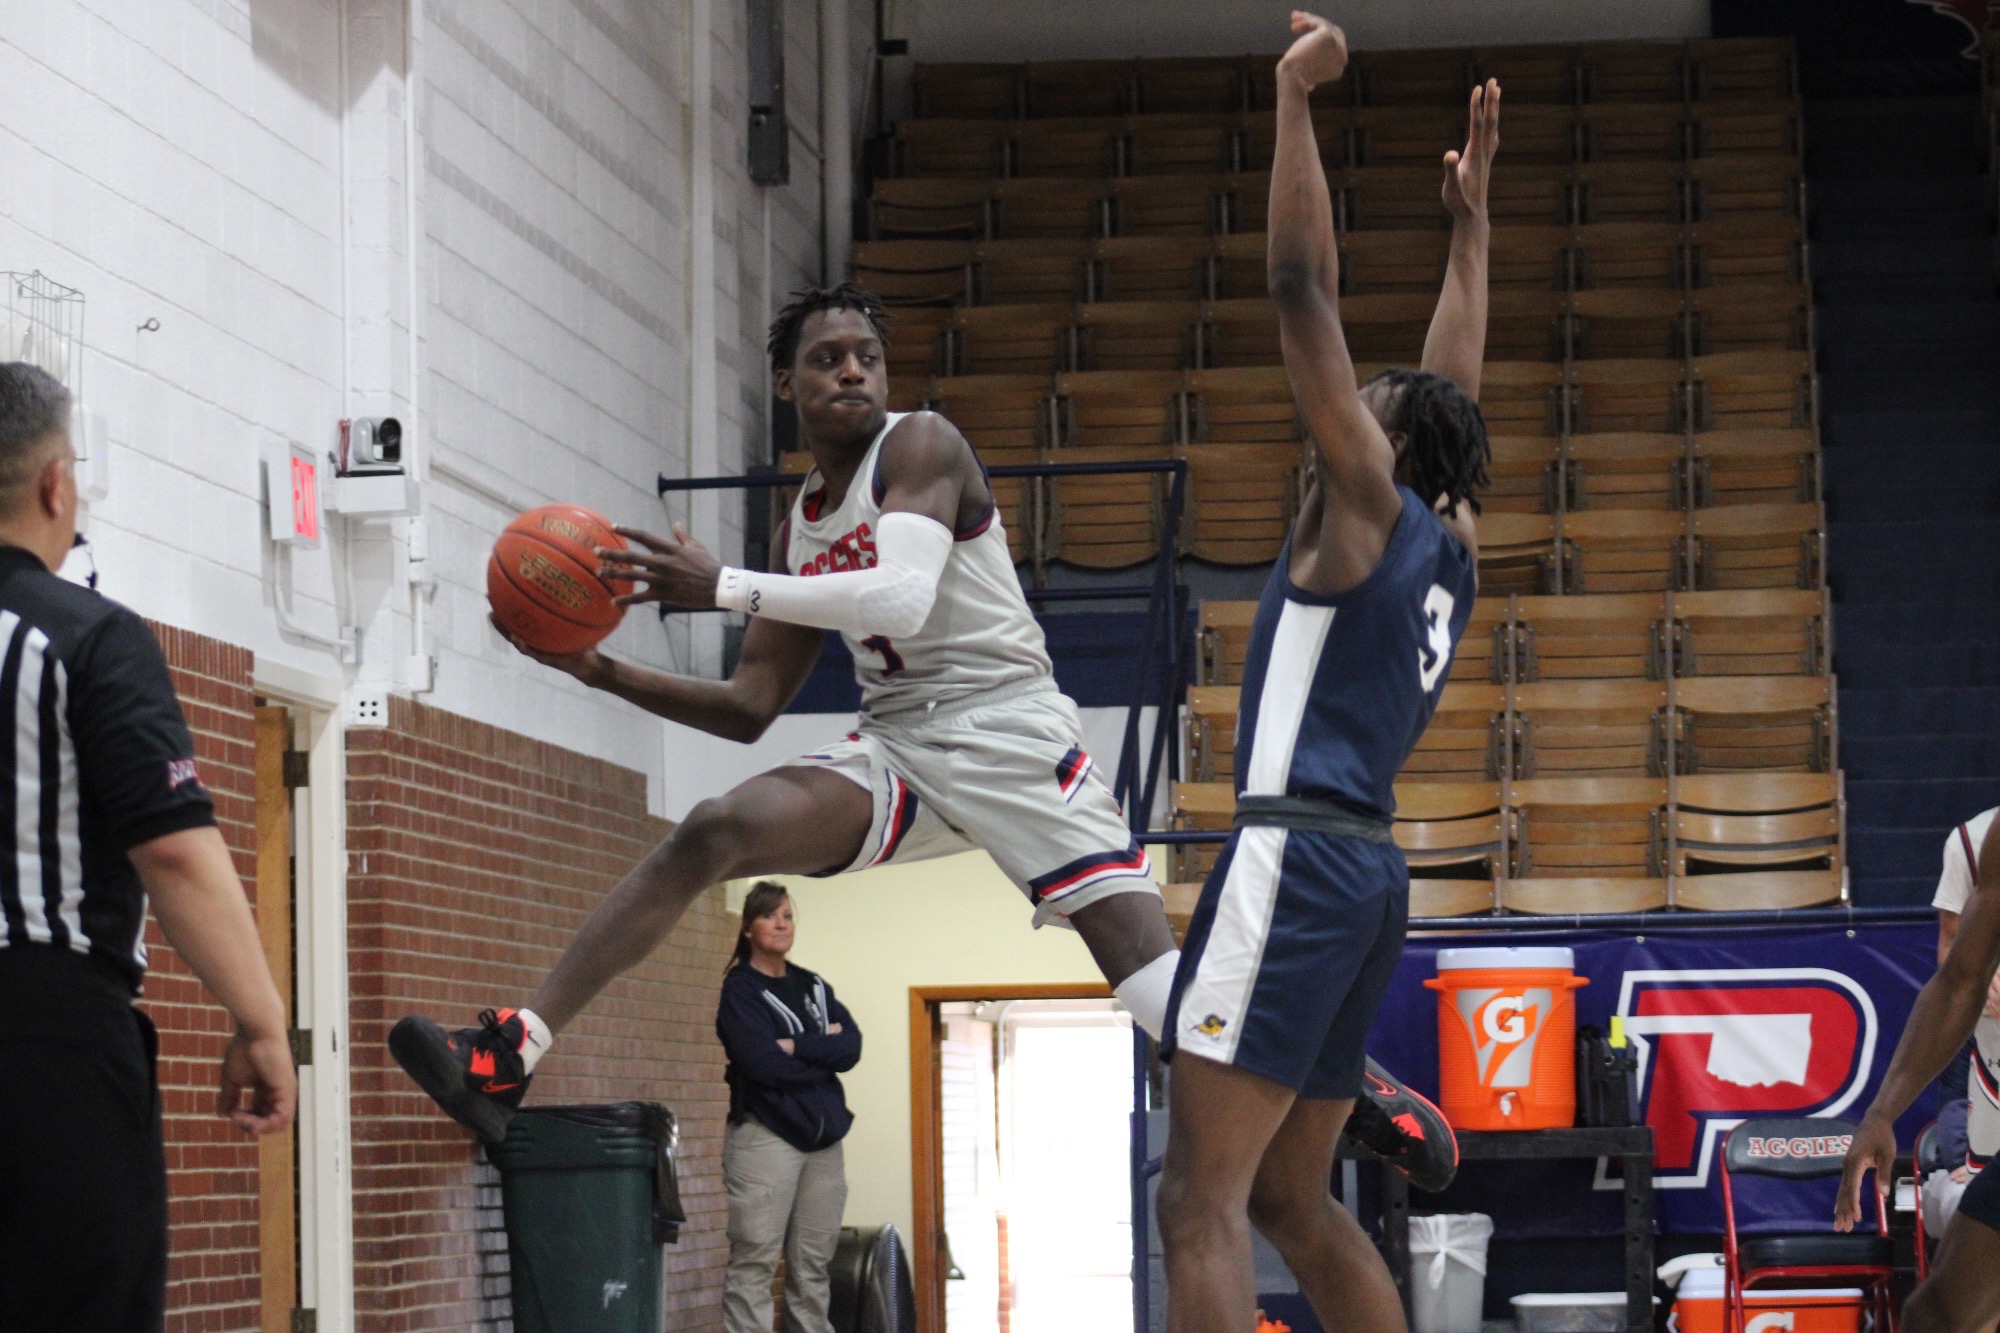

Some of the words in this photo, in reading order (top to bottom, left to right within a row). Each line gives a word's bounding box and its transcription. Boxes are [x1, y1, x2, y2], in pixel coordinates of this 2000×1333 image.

[292, 456, 318, 540] EXIT
[1418, 583, 1455, 693] 3
[1483, 995, 1525, 1044] G
[1747, 1135, 1853, 1158] AGGIES
